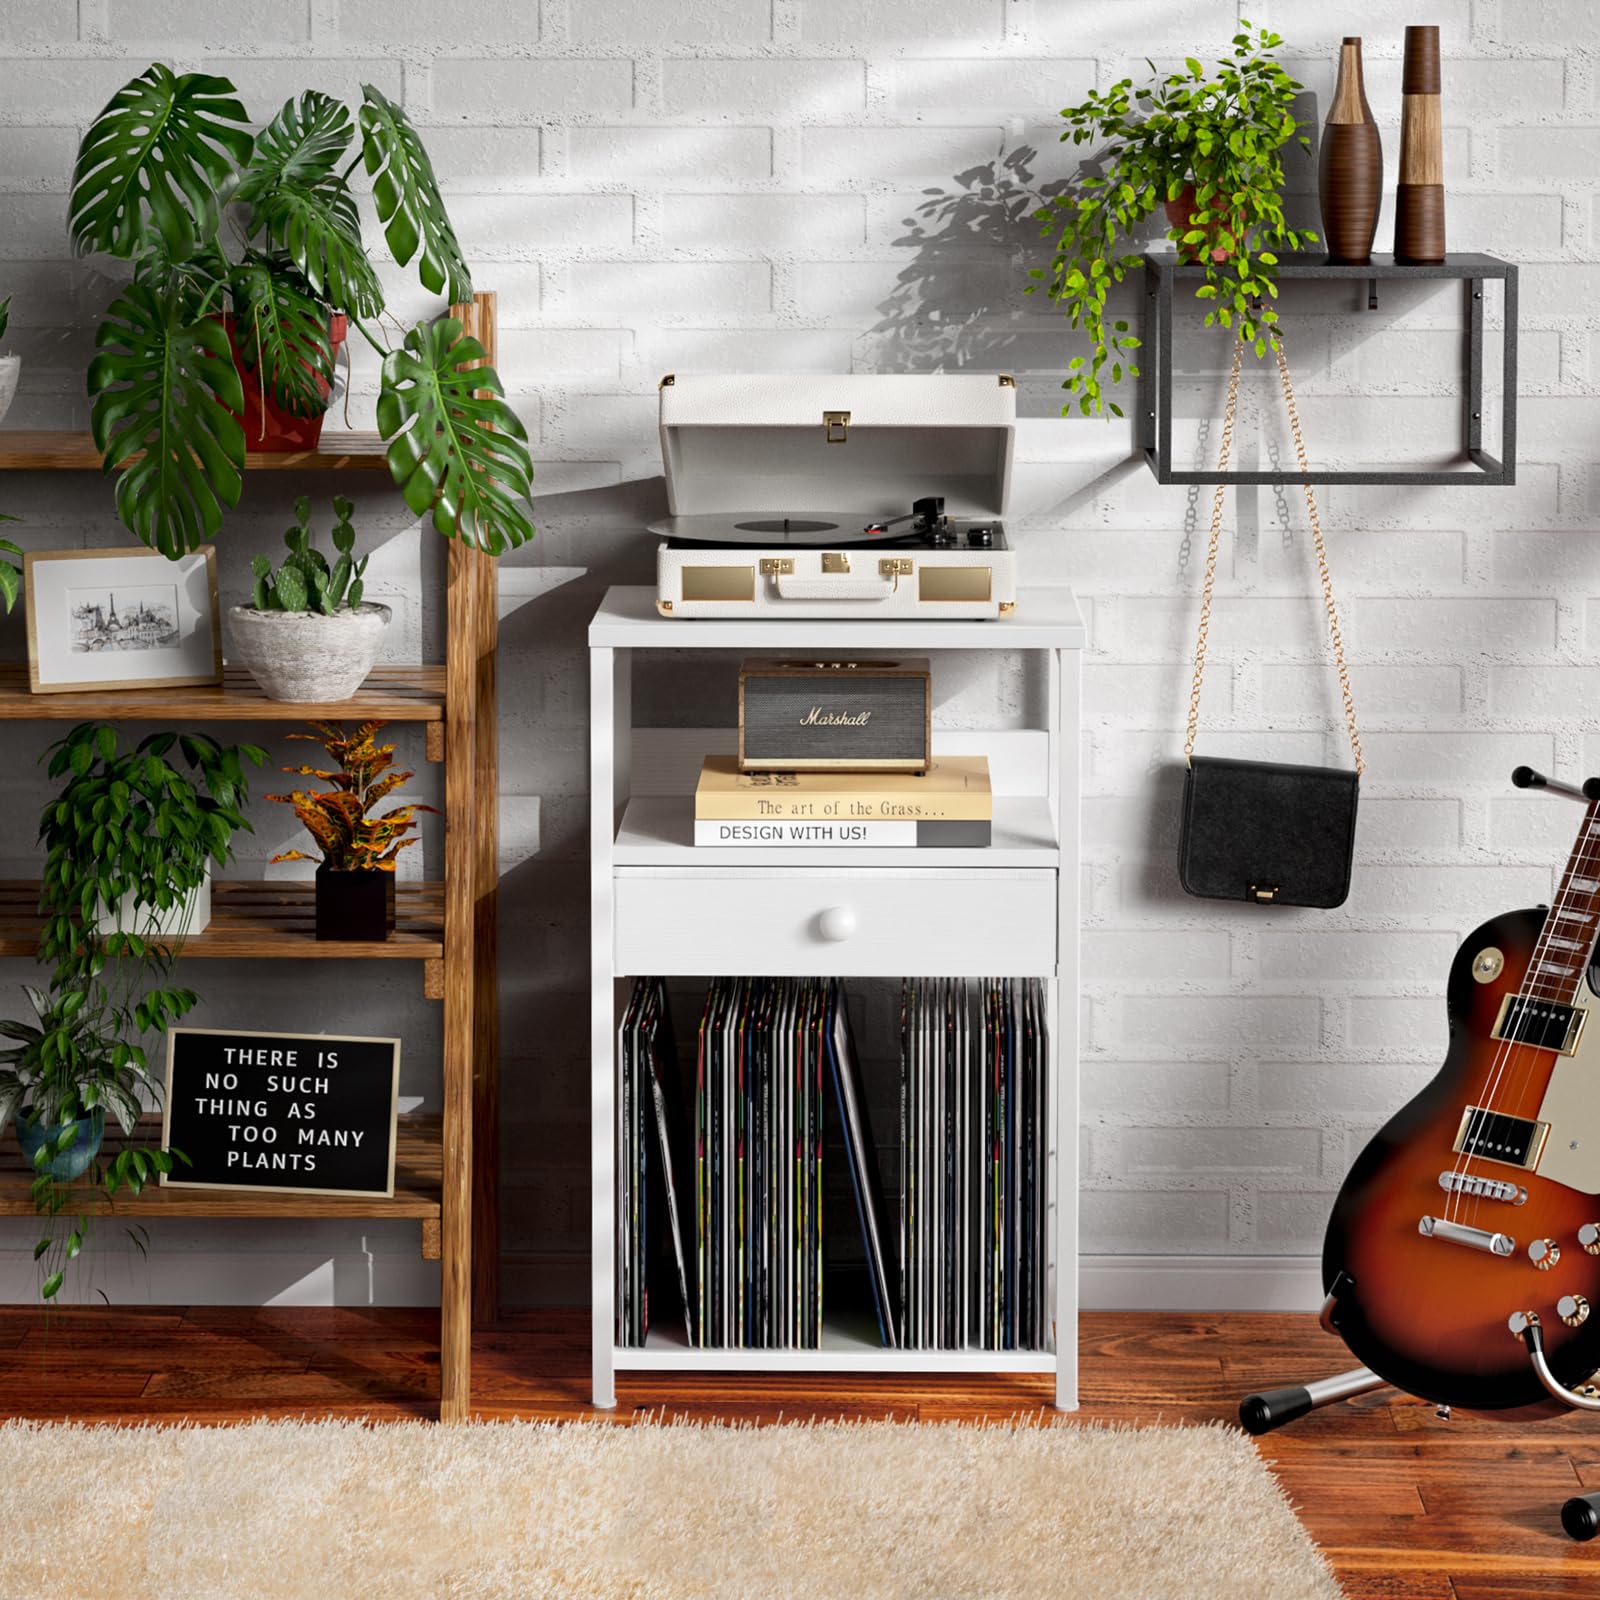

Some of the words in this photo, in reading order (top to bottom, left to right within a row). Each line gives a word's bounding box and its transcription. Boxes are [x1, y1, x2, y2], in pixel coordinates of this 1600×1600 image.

[799, 706, 871, 726] Marshall
[757, 799, 782, 815] The
[791, 801, 813, 815] art
[823, 800, 841, 816] of
[850, 800, 873, 816] the
[720, 826, 783, 840] DESIGN
[789, 826, 833, 840] WITH
[839, 826, 867, 840] US!
[223, 1047, 298, 1067] THERE
[318, 1052, 338, 1069] IS
[205, 1072, 238, 1090] NO
[267, 1075, 329, 1094] SUCH
[194, 1098, 267, 1117] THING
[287, 1102, 316, 1120] AS
[228, 1125, 277, 1144] TOO
[298, 1128, 364, 1148] MANY
[227, 1151, 316, 1171] PLANTS
